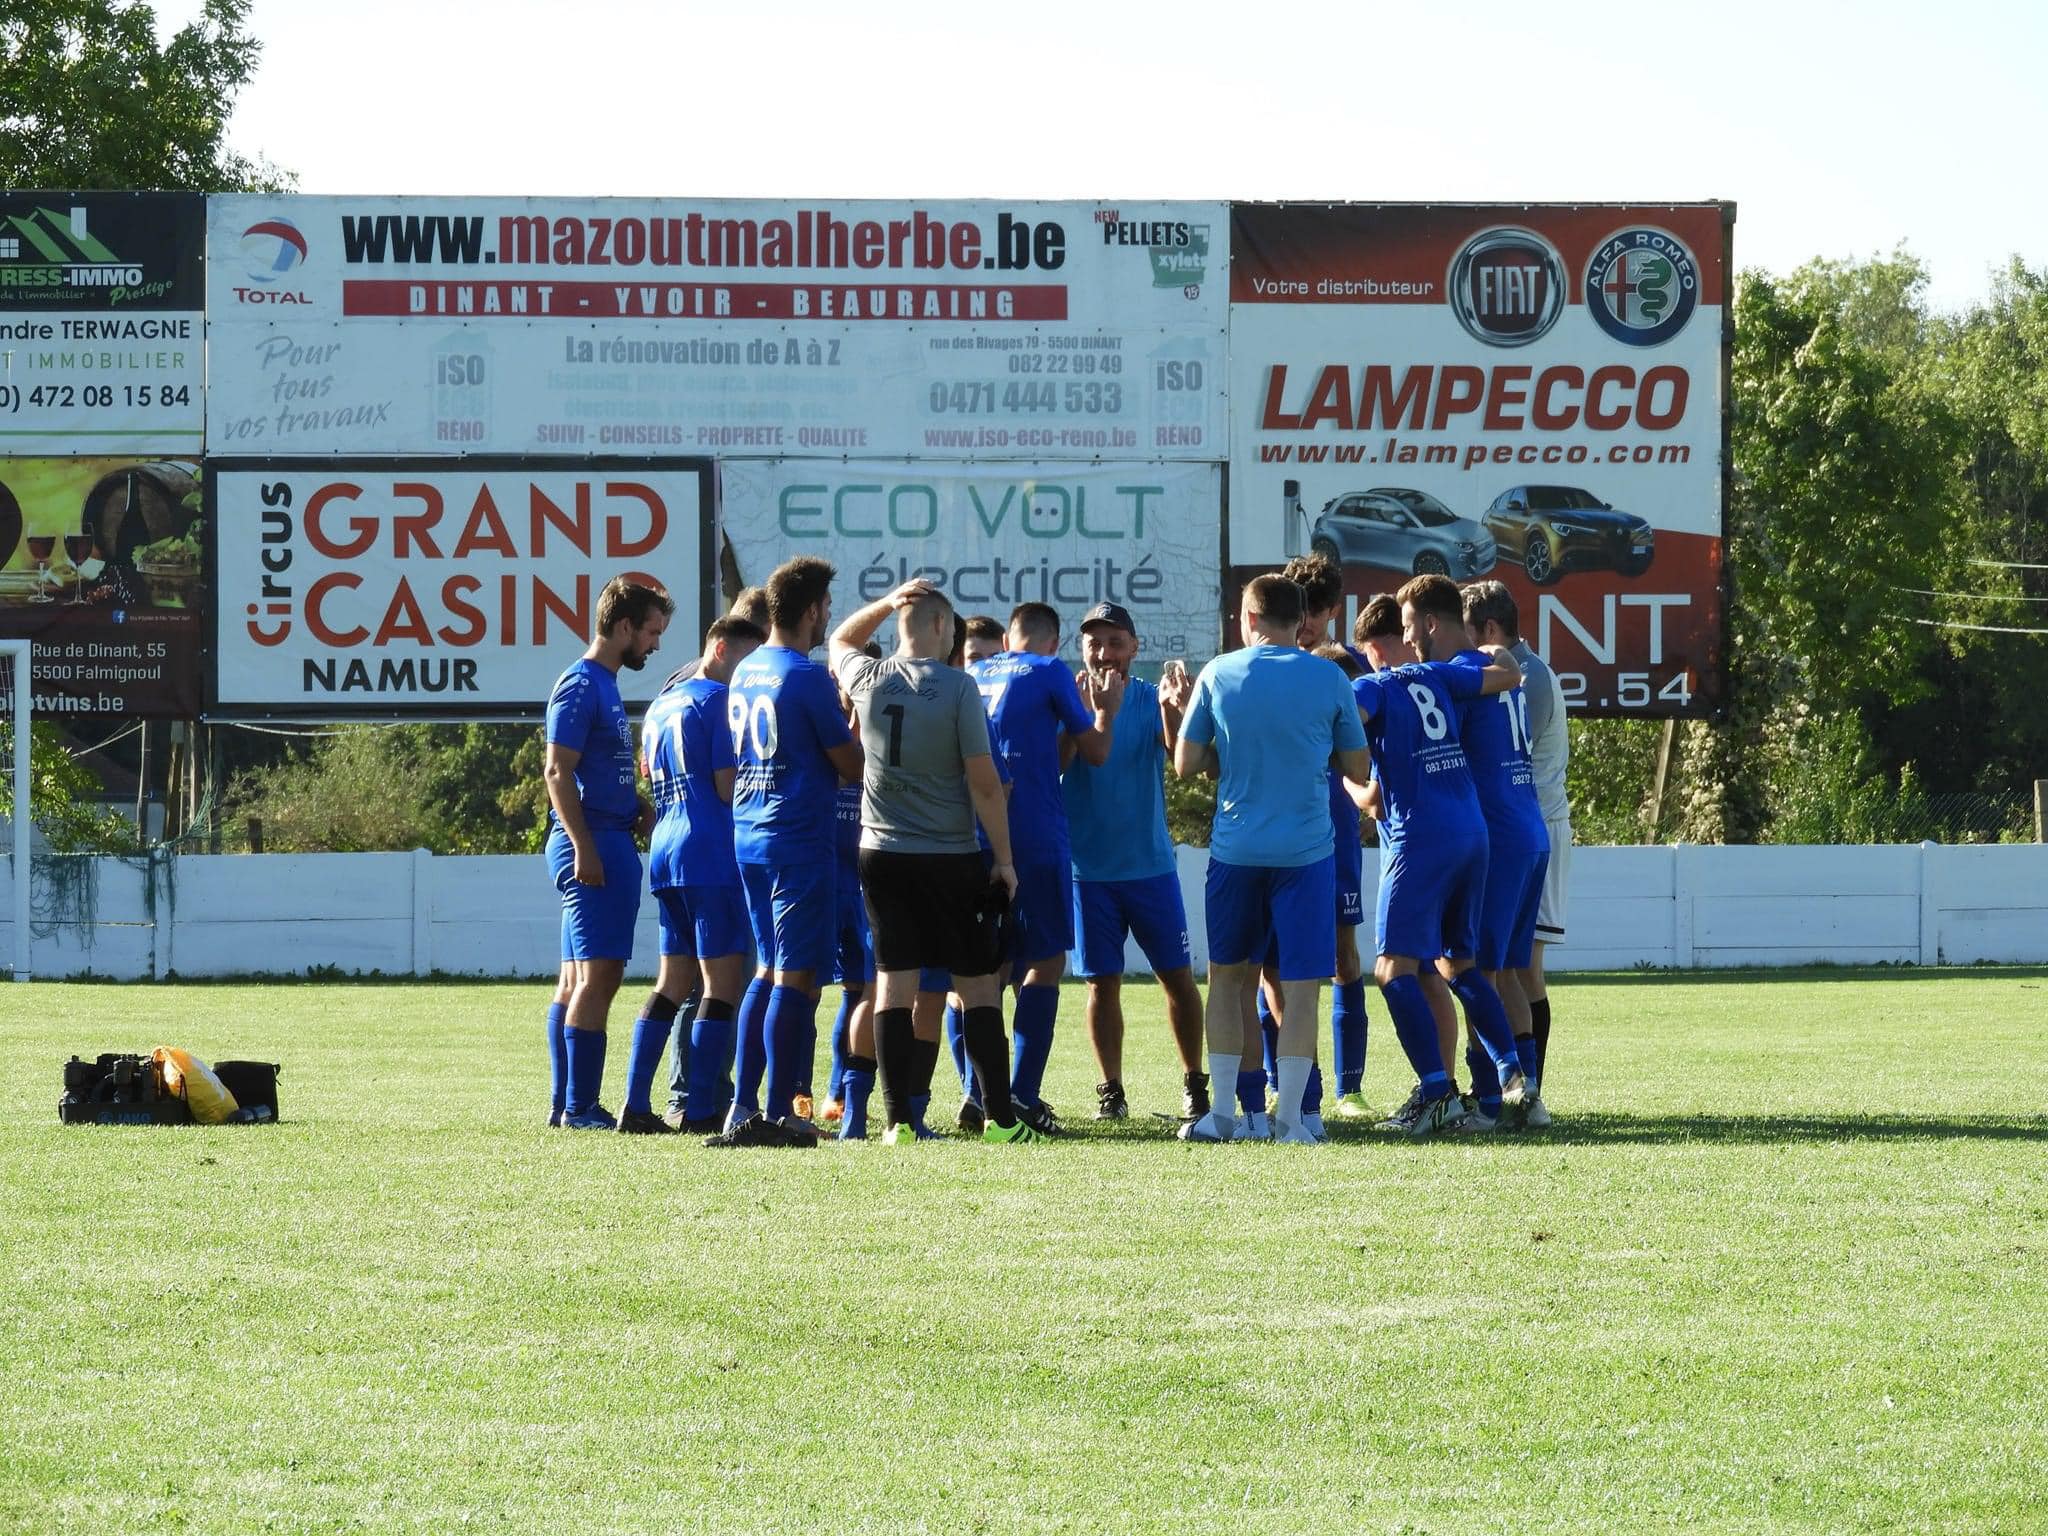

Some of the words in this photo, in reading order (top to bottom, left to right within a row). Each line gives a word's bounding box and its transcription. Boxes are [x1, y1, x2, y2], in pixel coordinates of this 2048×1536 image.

[1094, 210, 1119, 223] NEW
[342, 211, 1066, 270] www.mazoutmalherbe.be
[1104, 221, 1188, 246] PELLETS
[1590, 240, 1626, 289] ALFA
[1636, 234, 1694, 290] ROMEO
[409, 285, 553, 313] DINANT
[615, 287, 731, 315] YVOIR
[793, 288, 1013, 317] BEAURAING
[1253, 278, 1309, 295] Votre
[1317, 277, 1434, 295] distributeur
[1480, 265, 1541, 316] FIAT
[0, 320, 53, 339] ndre
[61, 320, 190, 339] TERWAGNE
[930, 338, 950, 349] rue
[952, 337, 974, 349] des
[977, 337, 1023, 351] Rivages
[1025, 337, 1039, 349] 79
[1048, 337, 1078, 349] 5500
[1081, 337, 1122, 350] DINANT
[29, 352, 185, 369] IMMOBILIER
[255, 336, 341, 370] Pour
[565, 336, 593, 364] La
[600, 335, 737, 366] rénovation
[746, 339, 779, 366] de
[784, 340, 801, 366] A
[806, 338, 824, 366] à
[827, 340, 841, 366] Z
[1009, 354, 1042, 374] 082
[1046, 354, 1068, 374] 22
[1072, 354, 1096, 374] 99
[1100, 354, 1122, 374] 49
[29, 386, 75, 407] 472
[83, 386, 113, 407] 08
[124, 386, 151, 407] 15
[160, 386, 190, 407] 84
[272, 370, 335, 404] tous
[929, 382, 995, 414] 0471
[1001, 382, 1058, 414] 444
[1065, 381, 1122, 414] 533
[1261, 363, 1690, 431] LAMPECCO
[223, 416, 267, 441] vos
[275, 400, 393, 436] travaux
[537, 424, 585, 444] SUIVI
[600, 425, 683, 445] CONSEILS
[697, 426, 784, 446] PROPRETE
[798, 427, 868, 447] QUALITE
[925, 426, 1137, 448] www.iso-eco-reno.be
[1260, 438, 1690, 471] www.lampecco.com
[303, 482, 668, 560] GRAND
[778, 485, 937, 539] ECO
[968, 484, 1164, 540] VOLT
[858, 553, 1164, 604] électricité
[32, 643, 61, 658] Rue
[65, 643, 84, 658] de
[88, 643, 142, 660] Dinant,
[147, 643, 166, 657] 55
[32, 665, 72, 680] 5500
[76, 665, 161, 683] Falmignoul
[304, 658, 479, 692] NAMUR
[728, 693, 778, 762] 90
[1407, 682, 1448, 741] 8
[881, 704, 905, 767] 1
[1343, 893, 1358, 906] 17
